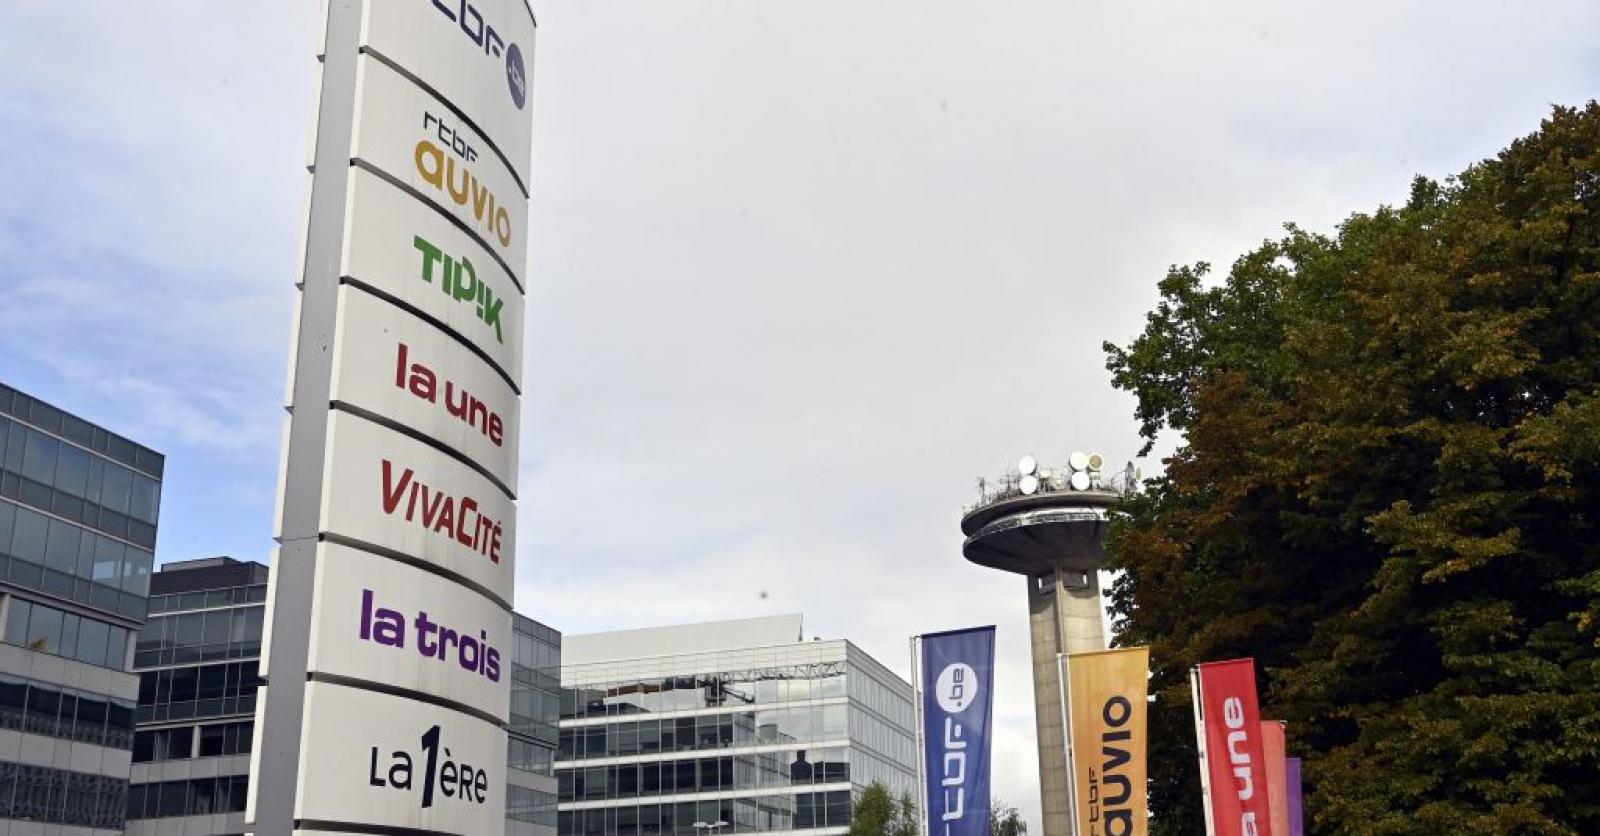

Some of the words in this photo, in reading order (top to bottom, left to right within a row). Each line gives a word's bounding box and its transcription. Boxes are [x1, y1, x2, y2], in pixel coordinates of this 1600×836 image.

[415, 140, 511, 248] auvio
[395, 343, 437, 404] la
[444, 382, 504, 448] une
[359, 589, 405, 651] la
[414, 611, 501, 683] trois
[1102, 695, 1133, 836] auvio
[1224, 697, 1253, 801] une
